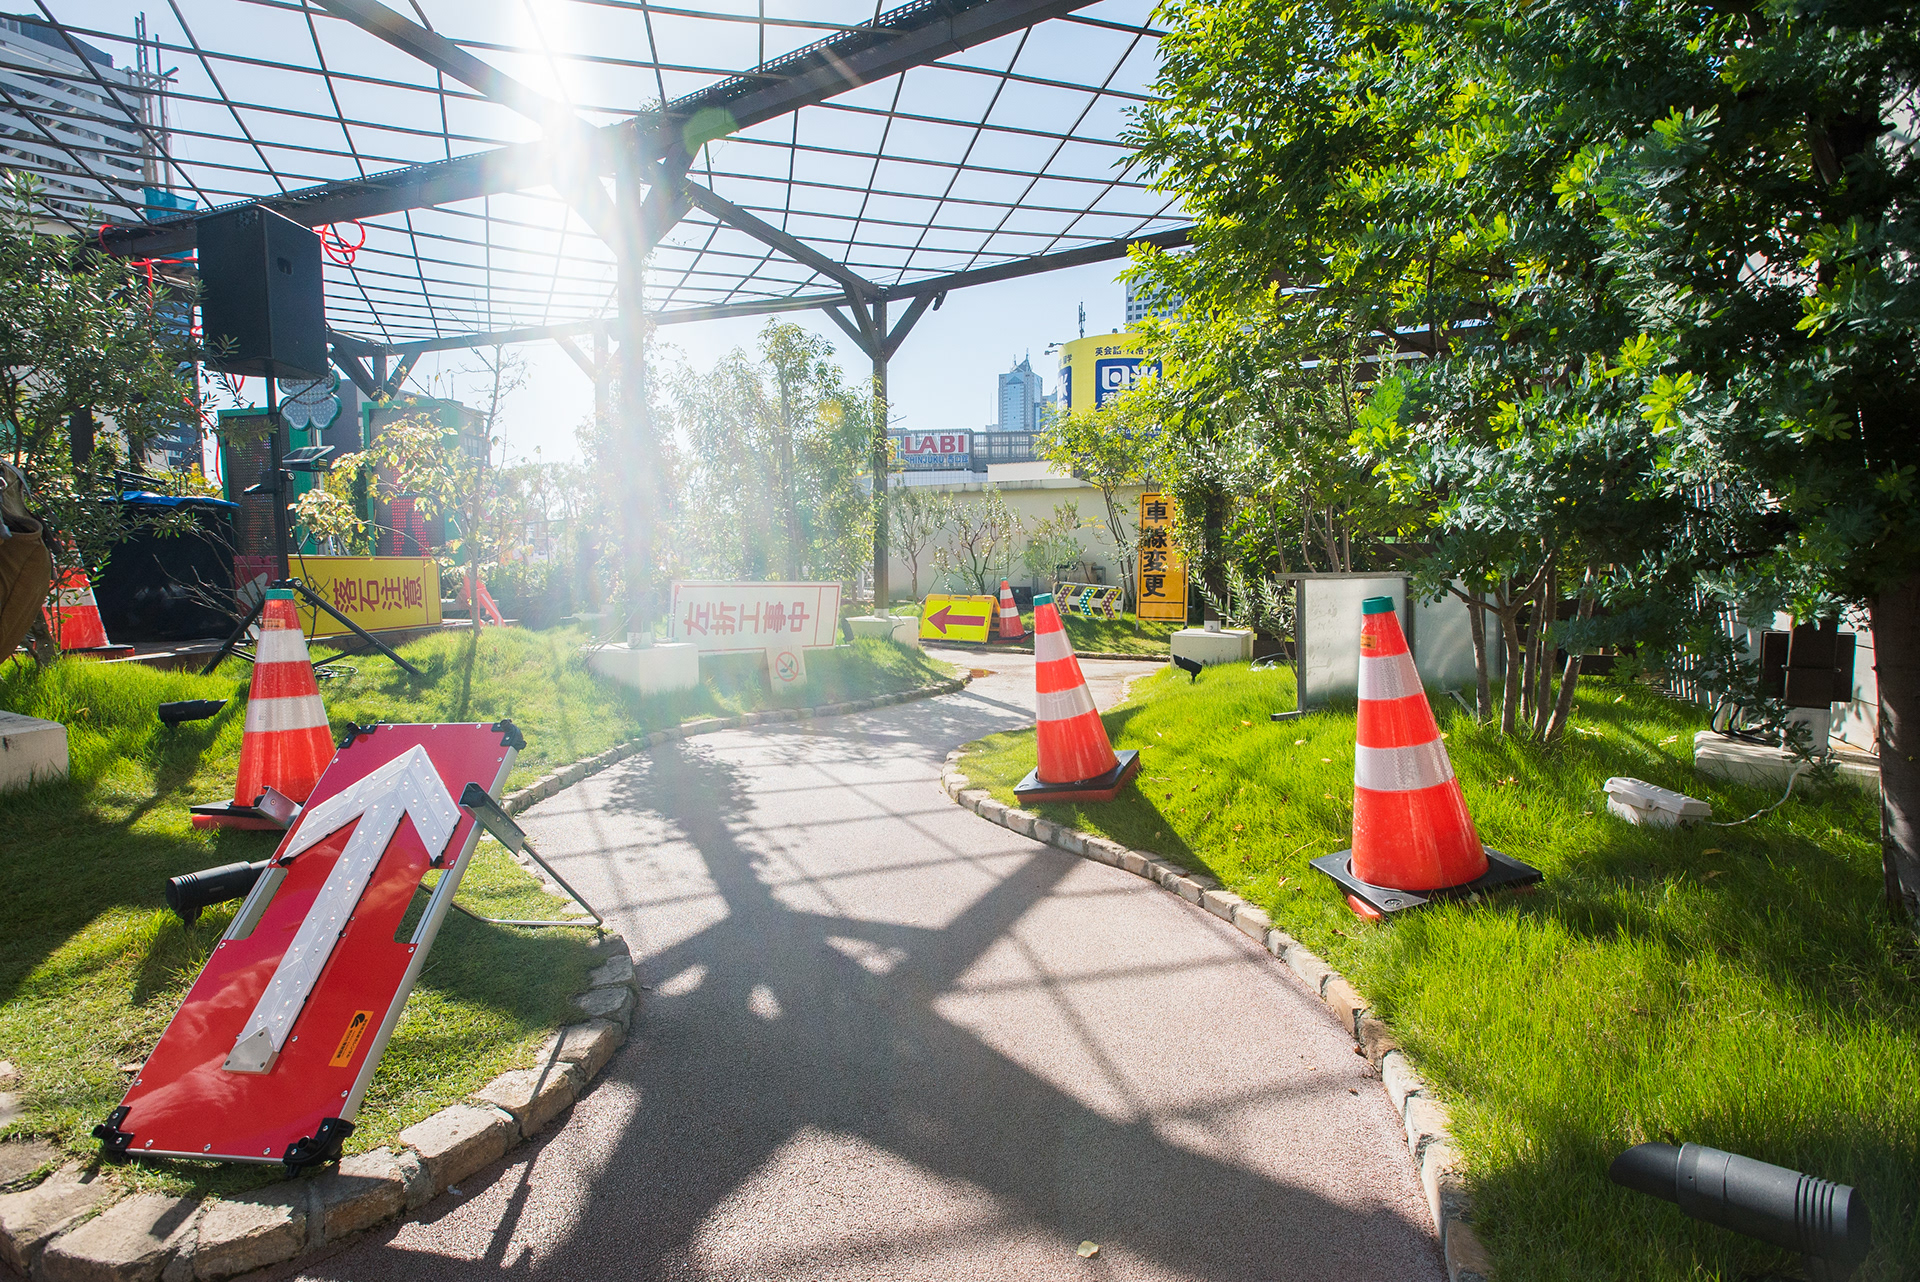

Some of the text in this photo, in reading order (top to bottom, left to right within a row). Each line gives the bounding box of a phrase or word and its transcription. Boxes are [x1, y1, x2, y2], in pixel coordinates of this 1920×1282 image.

[904, 435, 965, 454] LABI
[904, 455, 944, 465] SHINJUKU
[1142, 500, 1168, 598] 車線変更
[333, 576, 422, 613] 落石注意
[683, 601, 810, 636] 左折工事中
